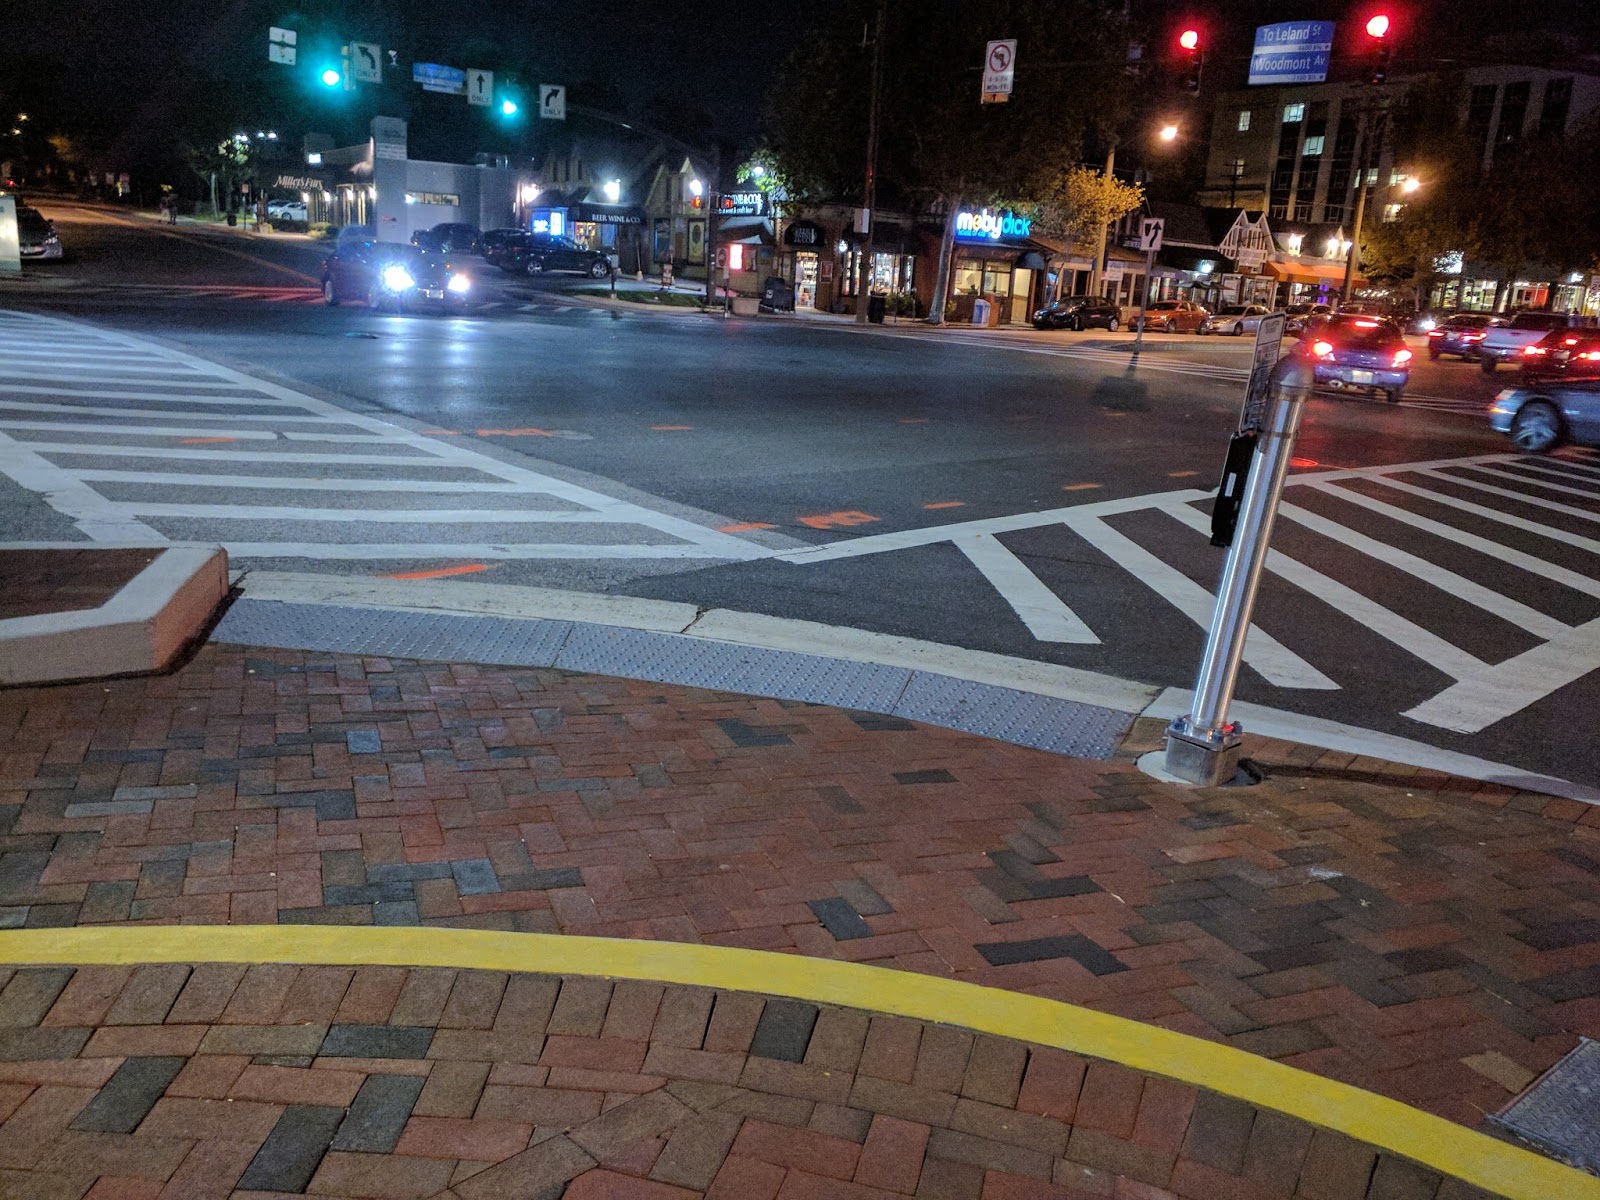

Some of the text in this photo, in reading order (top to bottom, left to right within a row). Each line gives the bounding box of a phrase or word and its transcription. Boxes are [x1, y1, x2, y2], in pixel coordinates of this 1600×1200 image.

[1263, 25, 1321, 42] To Leland St
[1254, 55, 1325, 71] Woodmont Av
[471, 94, 490, 102] ONLY
[543, 108, 562, 116] ONLY
[591, 213, 608, 222] BEER
[608, 214, 626, 223] WINE
